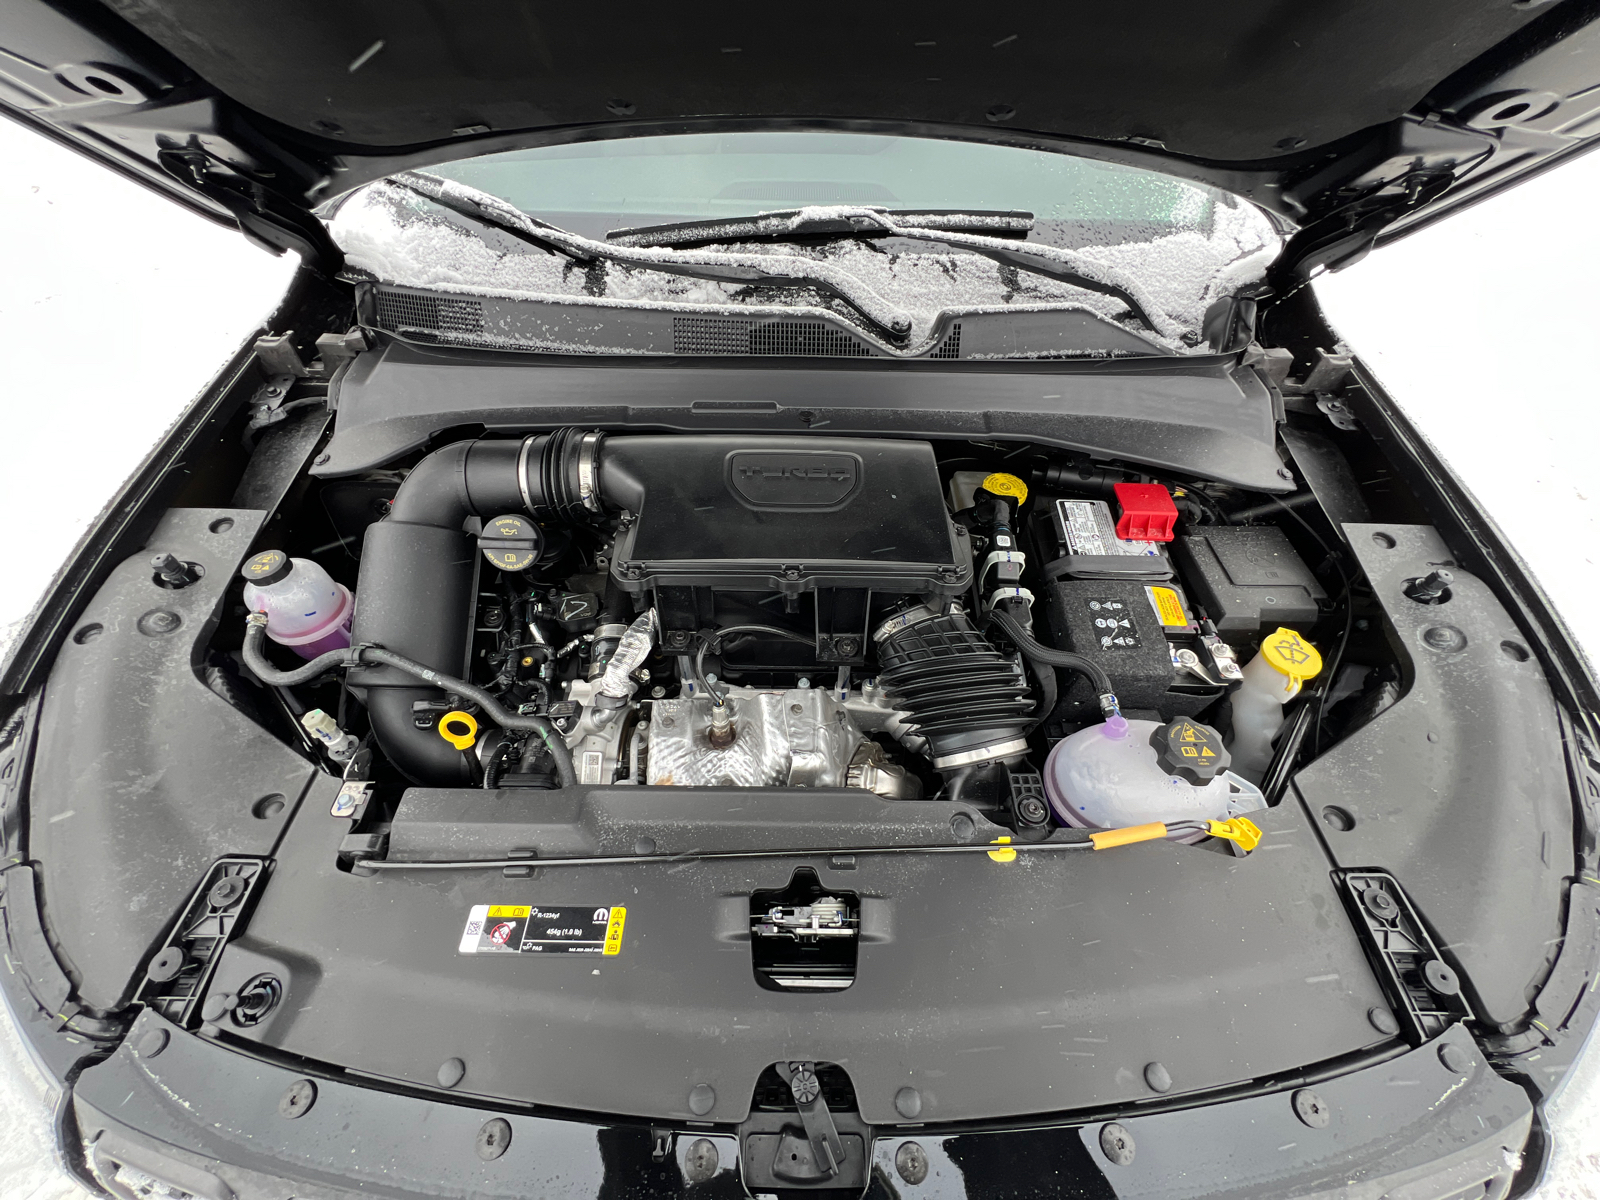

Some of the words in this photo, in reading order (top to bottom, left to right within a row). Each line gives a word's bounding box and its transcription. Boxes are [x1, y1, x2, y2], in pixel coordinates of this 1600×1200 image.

[495, 519, 513, 527] ENGINE
[537, 912, 560, 920] R-1234yf
[546, 928, 561, 936] 454g
